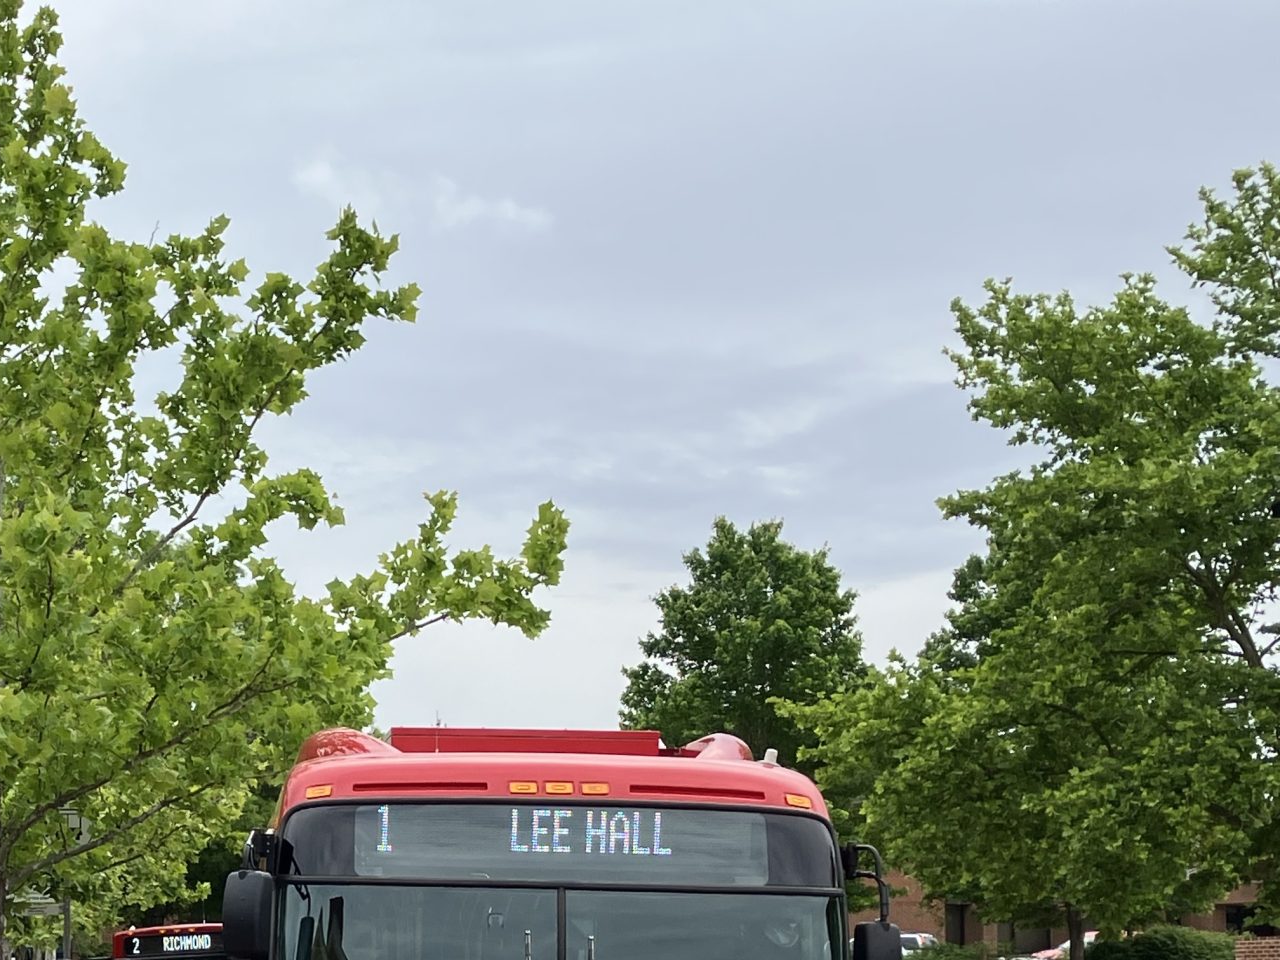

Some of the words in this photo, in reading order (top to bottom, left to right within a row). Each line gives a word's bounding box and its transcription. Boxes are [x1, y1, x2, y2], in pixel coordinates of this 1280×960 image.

[376, 804, 393, 852] 1
[510, 808, 572, 853] LEE
[585, 810, 672, 856] HALL
[132, 937, 141, 954] 2
[162, 934, 212, 952] RICHMOND
